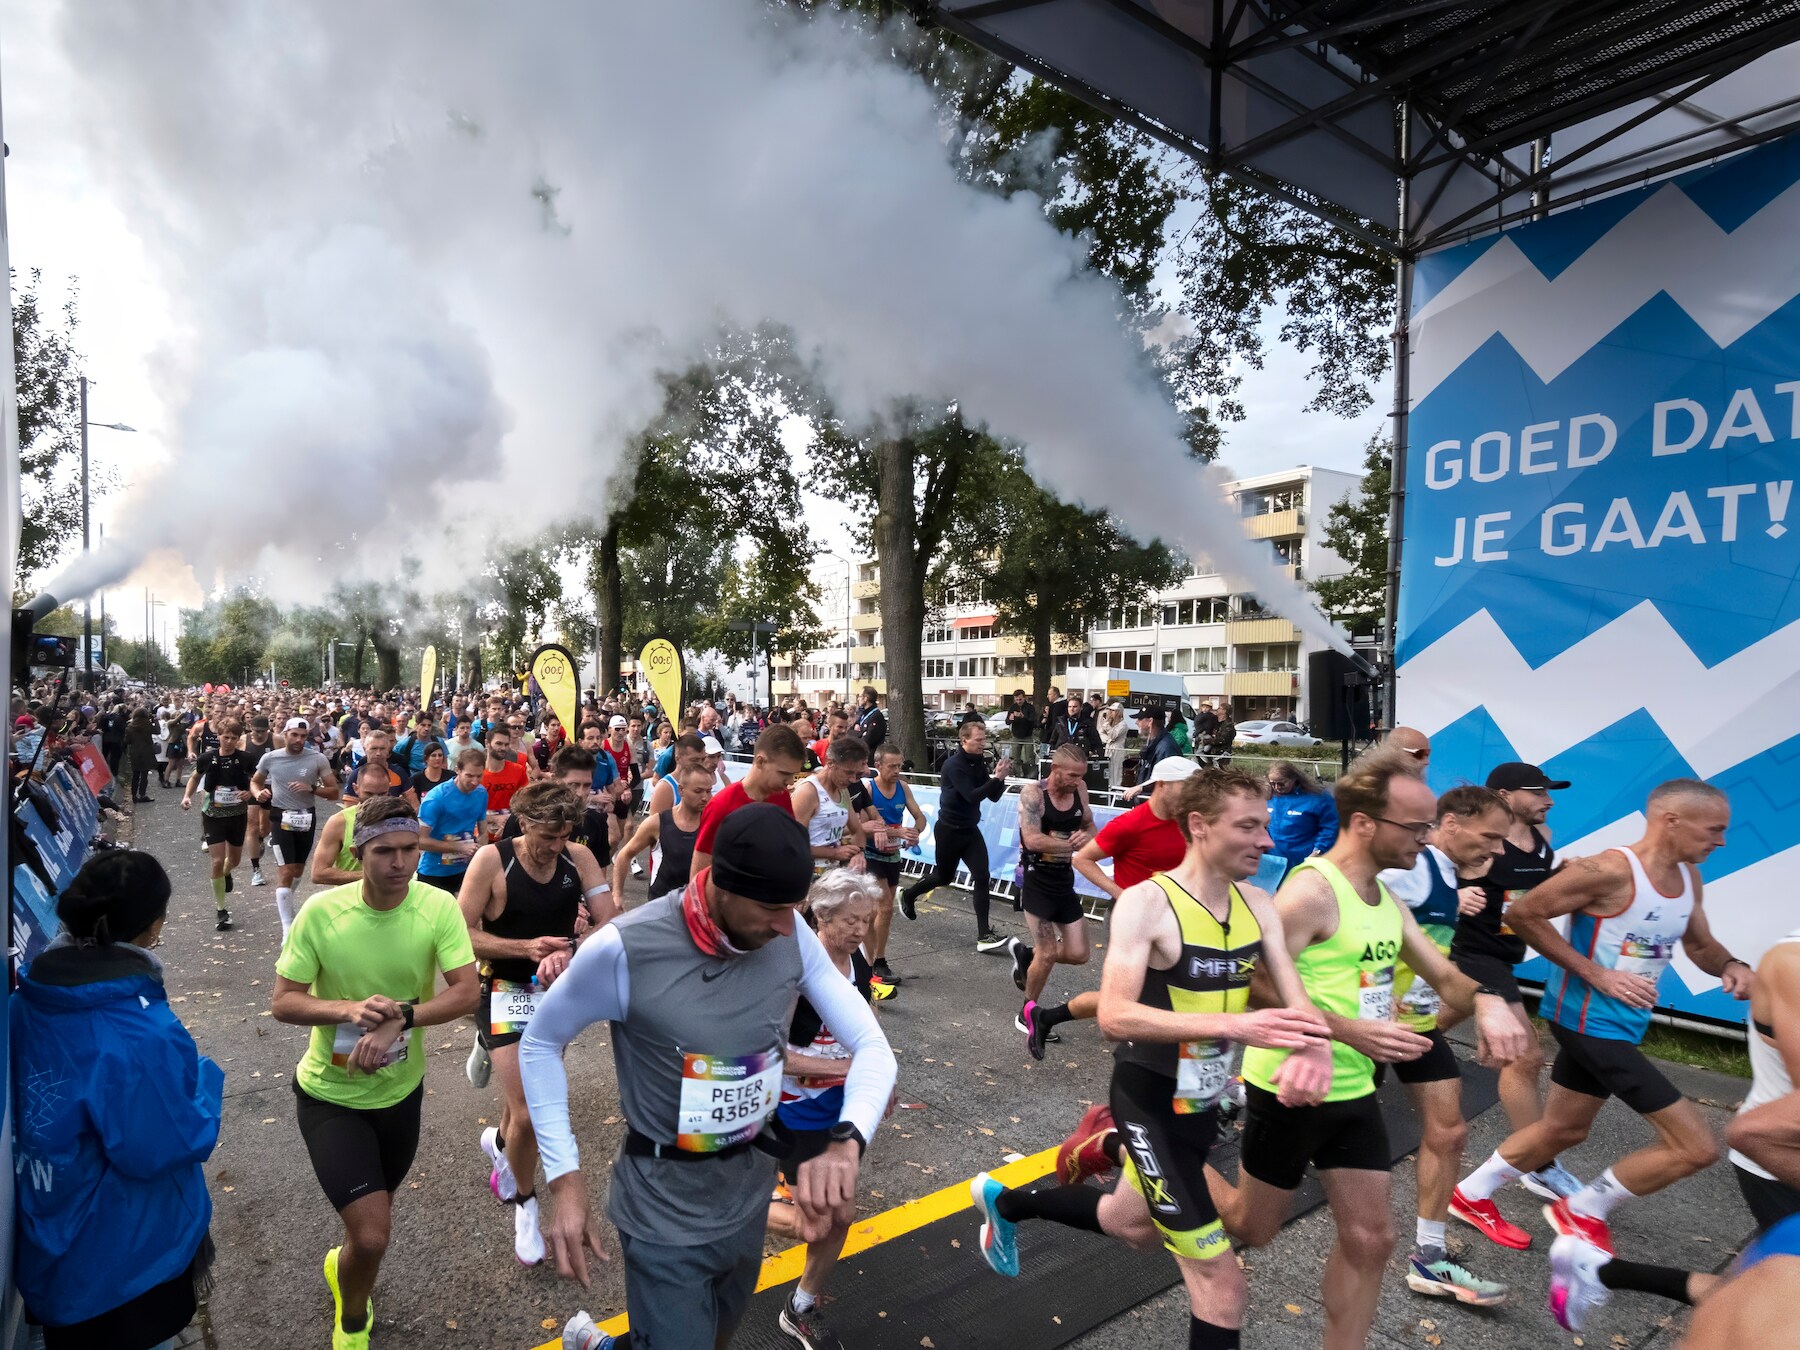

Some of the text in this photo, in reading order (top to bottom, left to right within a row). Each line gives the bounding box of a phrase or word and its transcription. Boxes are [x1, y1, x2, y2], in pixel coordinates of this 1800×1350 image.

[1425, 379, 1800, 490] GOED DAT
[1434, 479, 1793, 567] JE GAAT!
[711, 1097, 760, 1123] 4365
[712, 1079, 763, 1103] PETER
